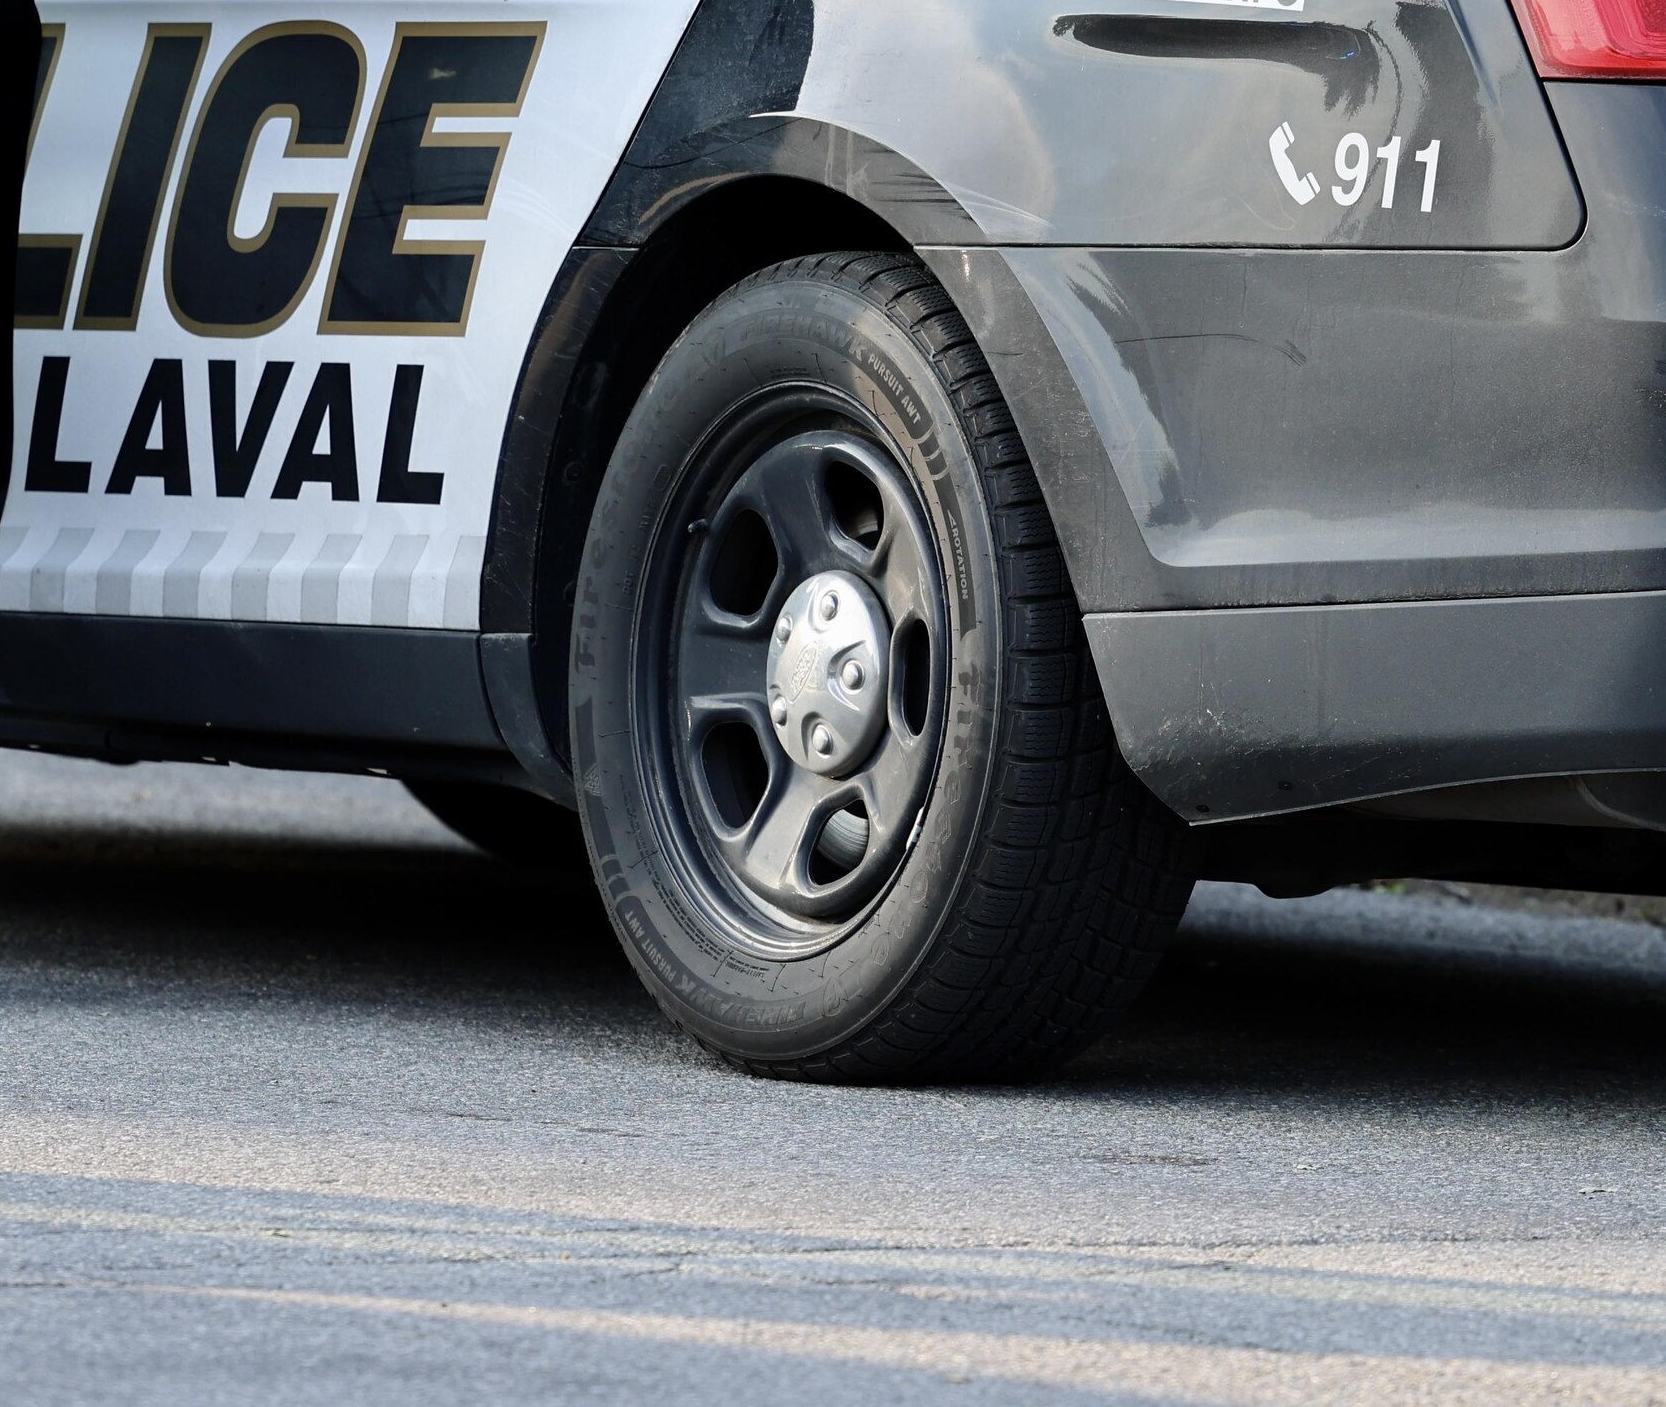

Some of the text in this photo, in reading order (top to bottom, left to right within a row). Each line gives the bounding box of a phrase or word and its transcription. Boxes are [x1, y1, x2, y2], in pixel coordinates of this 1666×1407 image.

[14, 19, 548, 338] ICE
[1331, 131, 1441, 213] 911
[867, 354, 904, 397] PURSUIT
[901, 395, 923, 425] AWT
[24, 355, 445, 506] LAVAL
[950, 527, 969, 600] ROTATION
[624, 909, 649, 942] AWT
[642, 940, 677, 983] PURSUIT
